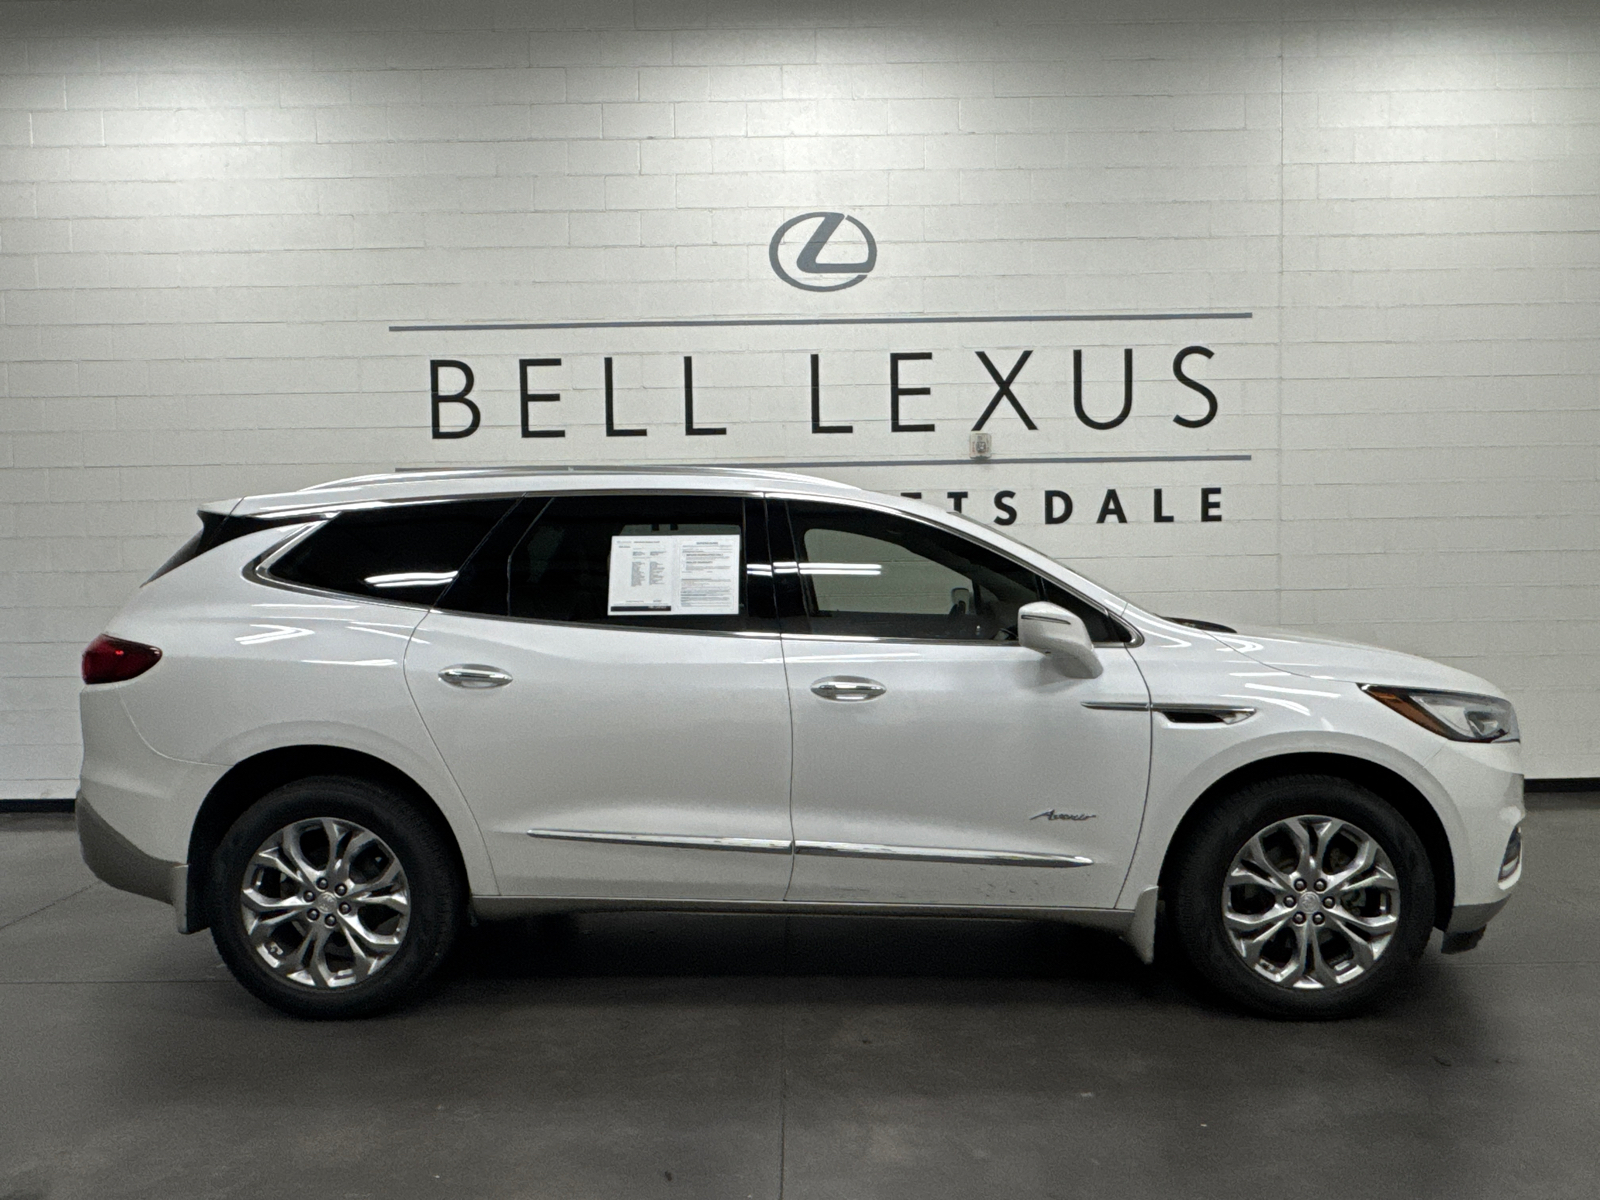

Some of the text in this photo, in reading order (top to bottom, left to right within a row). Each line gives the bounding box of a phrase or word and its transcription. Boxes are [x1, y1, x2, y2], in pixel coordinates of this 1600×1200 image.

[430, 345, 1218, 439] BELL LEXUS
[900, 488, 1222, 526] TSDALE
